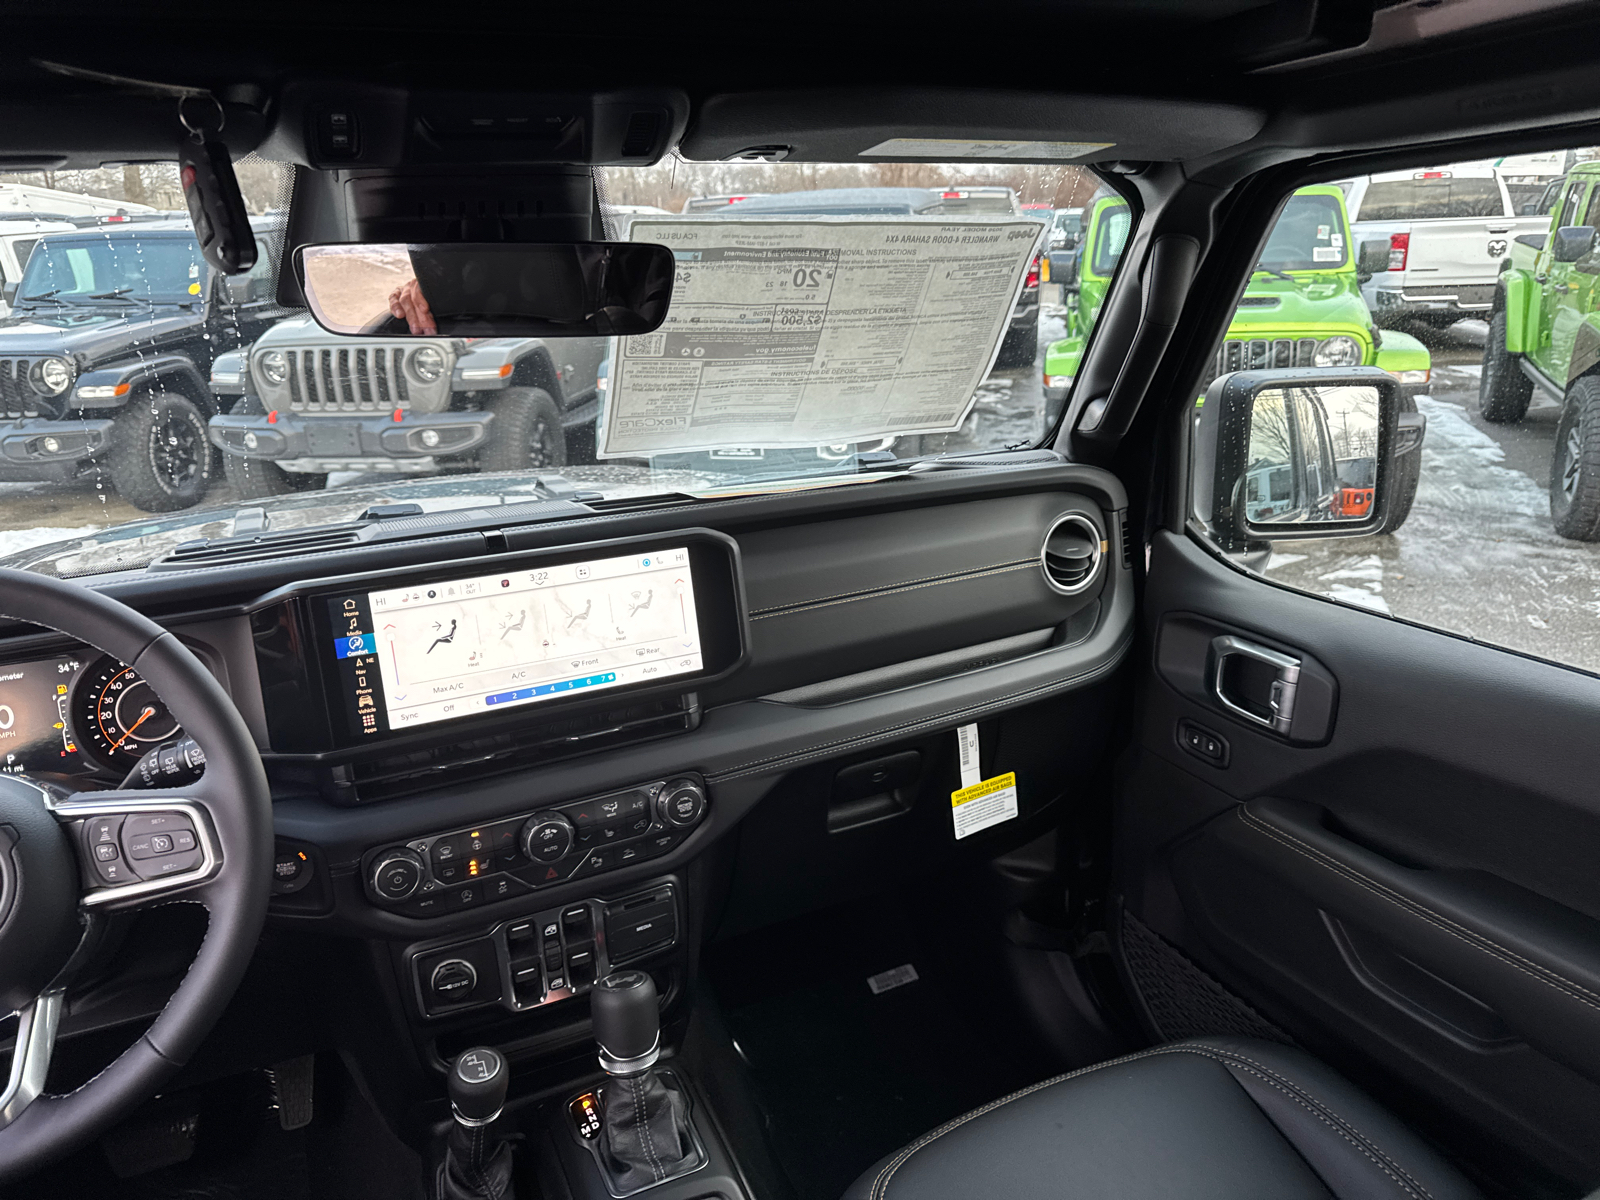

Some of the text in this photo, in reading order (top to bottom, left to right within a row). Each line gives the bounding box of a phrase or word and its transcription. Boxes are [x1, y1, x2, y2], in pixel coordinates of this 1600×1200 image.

[866, 248, 917, 257] INSTRUCTIONS
[771, 369, 819, 378] INSTRUCTIONS
[675, 553, 685, 562] HI
[529, 571, 549, 582] 3:22
[375, 597, 387, 606] HI
[343, 610, 360, 618] Home
[346, 648, 369, 657] Comfort
[646, 647, 661, 655] Rear
[581, 658, 599, 667] Front
[57, 661, 80, 674] 34°F
[642, 666, 658, 674] Auto
[124, 672, 135, 680] 50
[511, 671, 527, 680] A/C
[110, 681, 123, 691] 40
[432, 682, 465, 694] Max A/C
[355, 687, 373, 695] Phone
[103, 697, 114, 705] 30
[357, 706, 377, 715] Vehicle
[443, 705, 455, 713] Off
[100, 711, 113, 720] 20
[400, 712, 419, 721] Sync
[363, 726, 378, 734] Apps
[6, 754, 16, 765] P
[955, 792, 966, 800] THIS
[966, 784, 985, 795] VEHICLE
[990, 775, 1013, 787] EQUIPPED
[956, 796, 968, 805] WITH
[968, 788, 992, 800] ADVANCED
[1000, 781, 1013, 789] BAGS
[632, 801, 644, 809] A/C
[179, 837, 191, 845] RES
[132, 842, 150, 851] CANC
[636, 923, 652, 932] MEDIA
[585, 1107, 594, 1116] R
[588, 1114, 597, 1123] N
[580, 1125, 591, 1135] M
[591, 1121, 600, 1130] D
